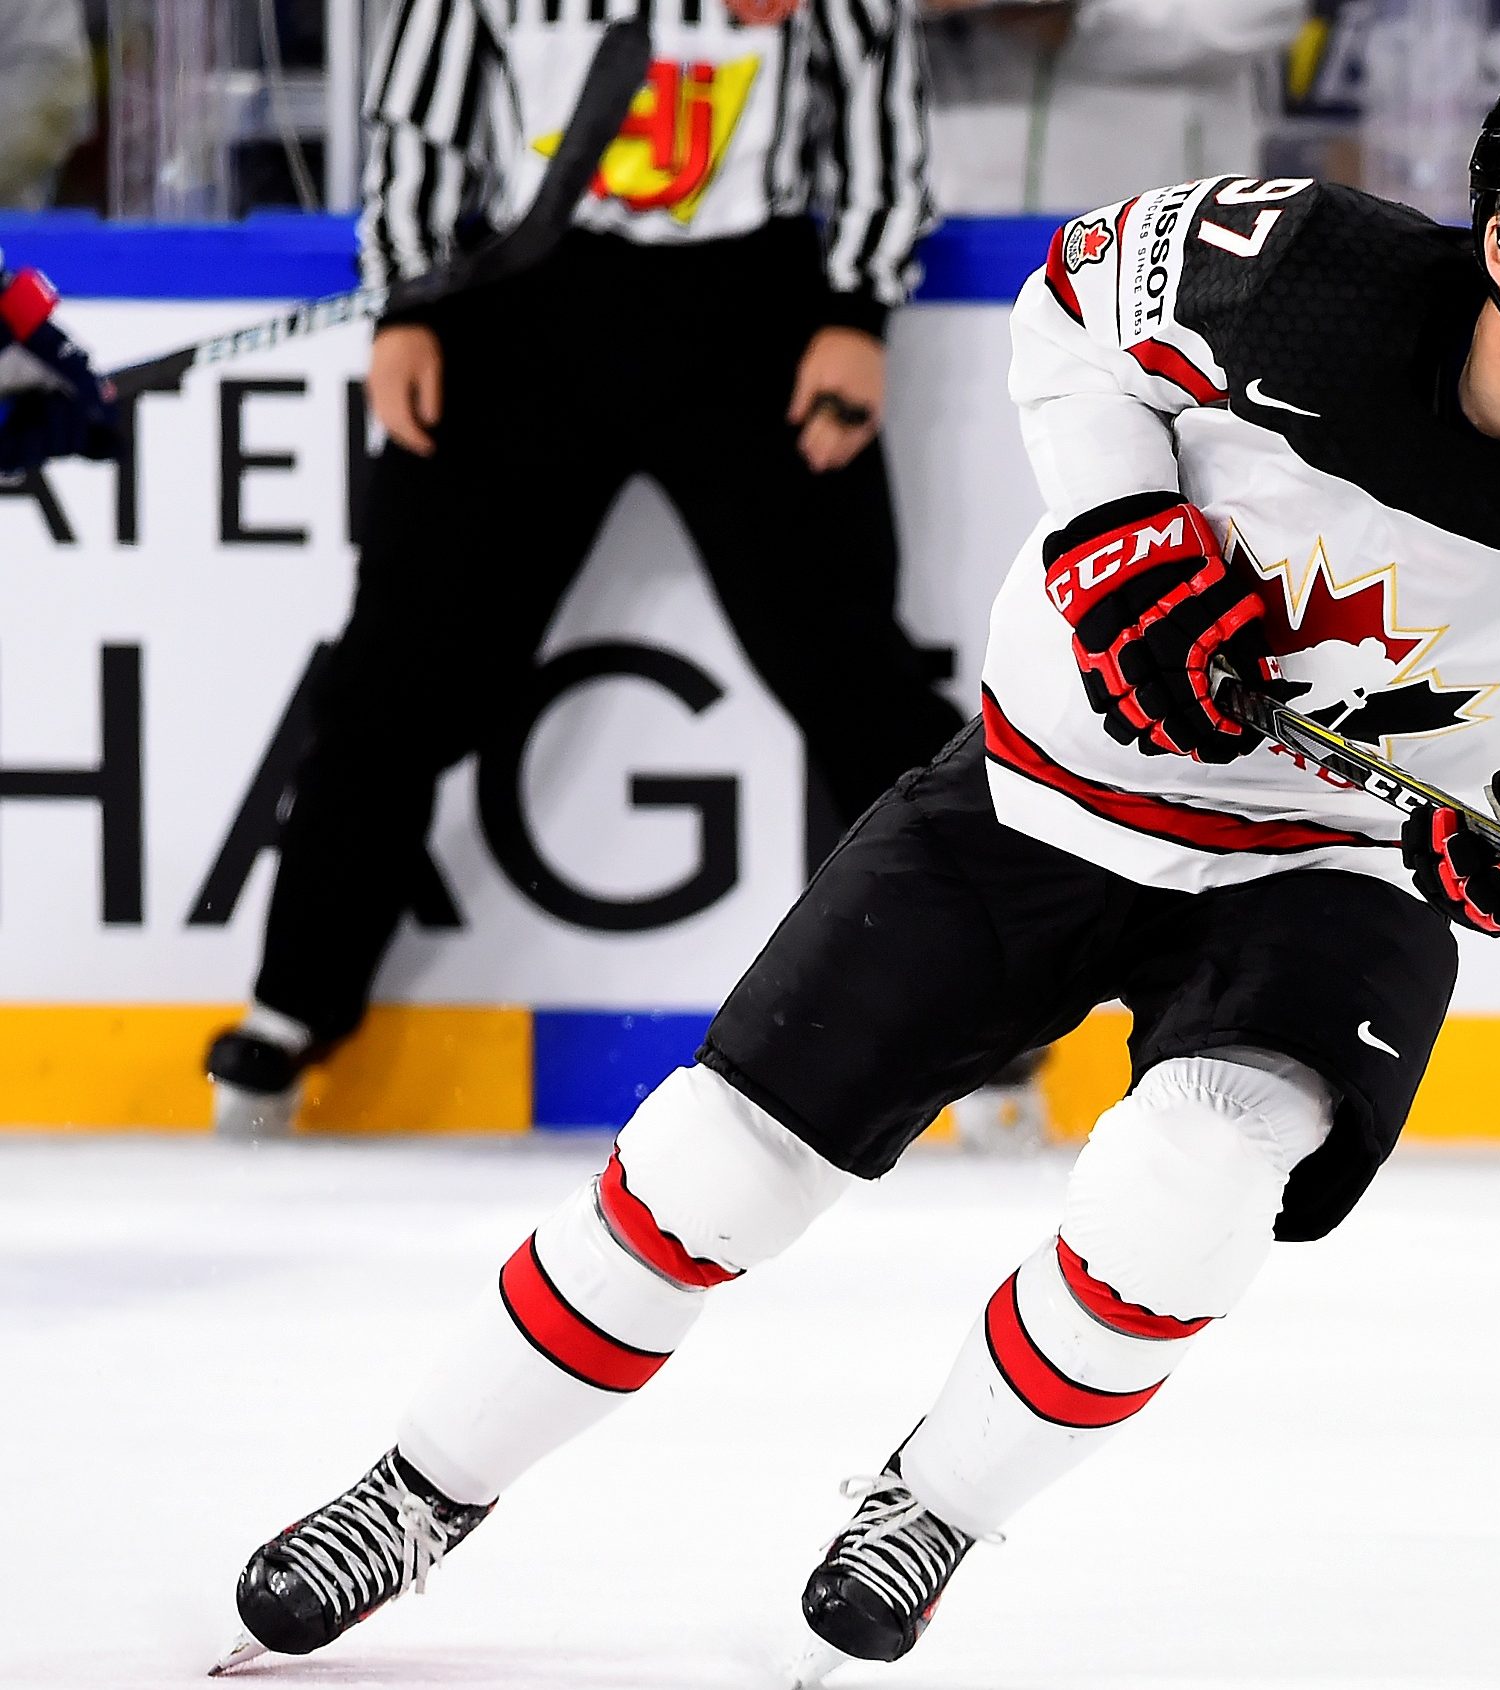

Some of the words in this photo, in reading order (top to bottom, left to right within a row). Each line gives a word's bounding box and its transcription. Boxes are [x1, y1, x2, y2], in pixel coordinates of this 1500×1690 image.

[1198, 178, 1314, 258] 97
[1134, 247, 1146, 294] SINCE
[1147, 181, 1203, 326] TISSOT
[1133, 301, 1142, 336] 1853
[1047, 517, 1184, 612] CCM
[1364, 769, 1440, 814] CC
